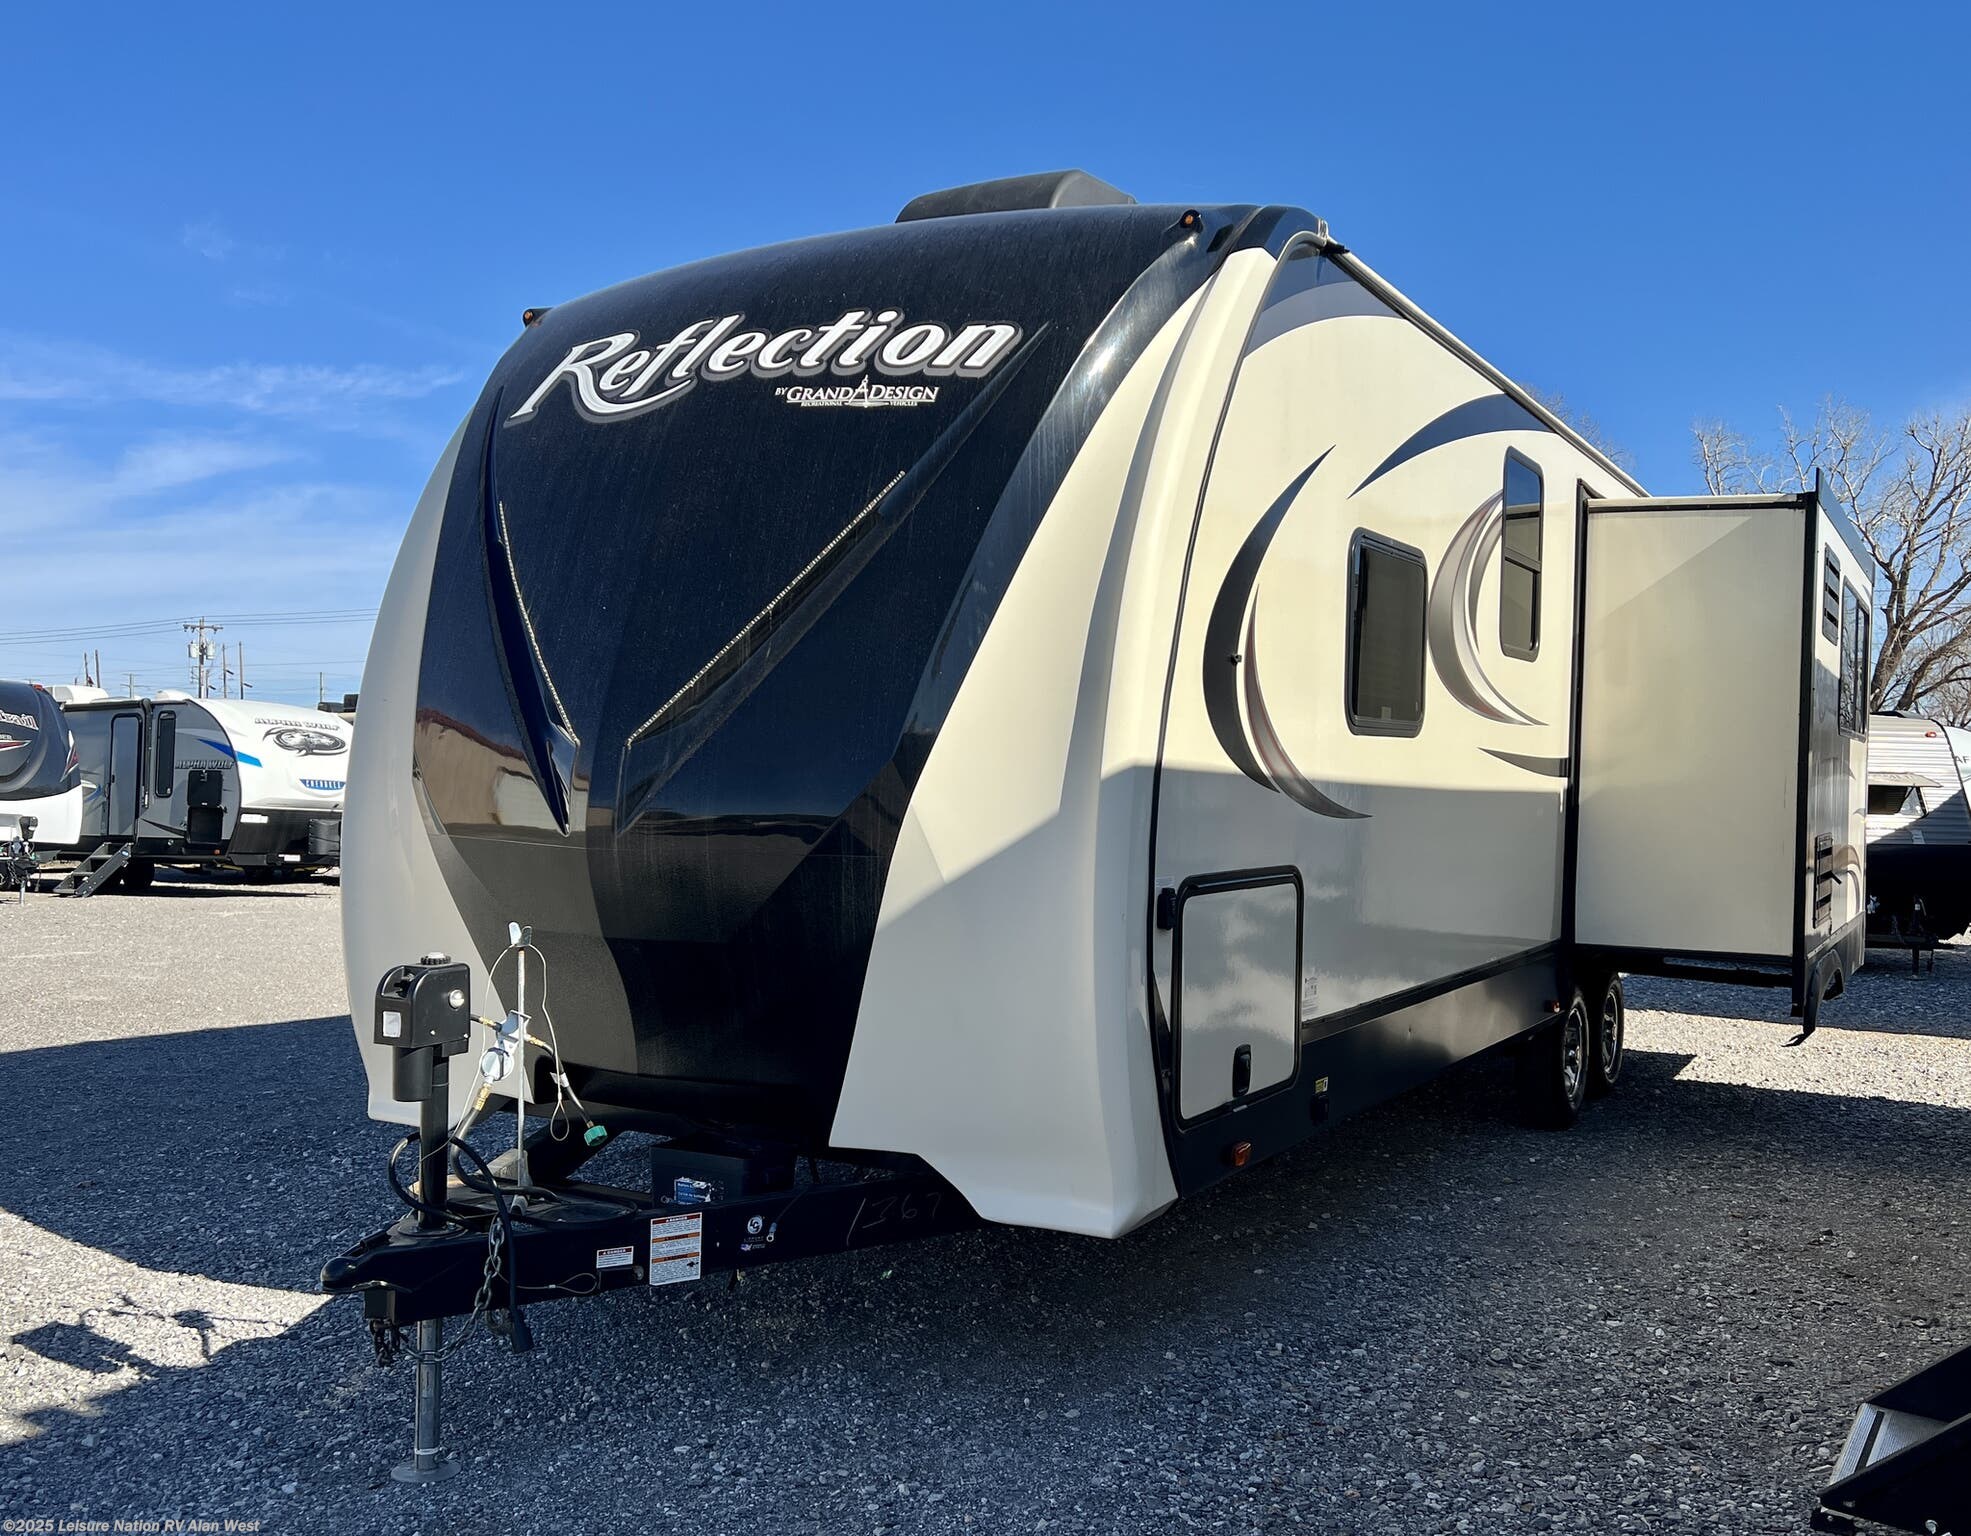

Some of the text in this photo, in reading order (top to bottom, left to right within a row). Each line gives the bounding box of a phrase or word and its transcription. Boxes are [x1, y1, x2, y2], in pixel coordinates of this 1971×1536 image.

[506, 309, 1018, 421] Reflection
[775, 385, 939, 400] BY GRAND DESIGN
